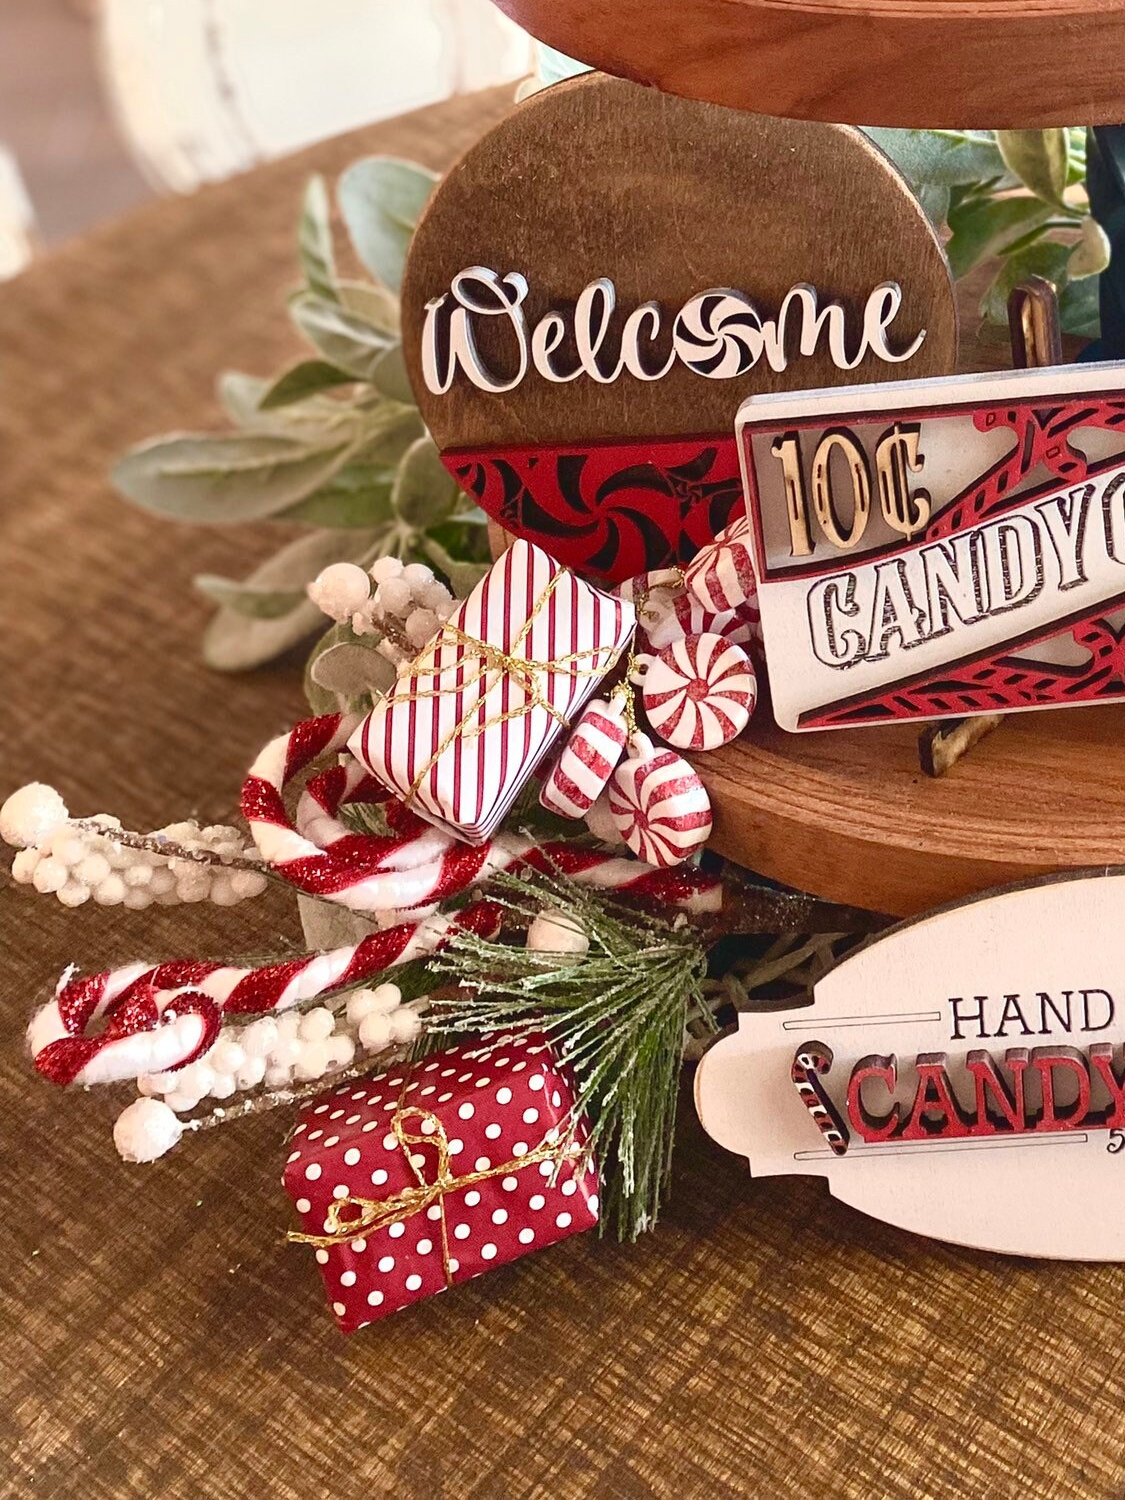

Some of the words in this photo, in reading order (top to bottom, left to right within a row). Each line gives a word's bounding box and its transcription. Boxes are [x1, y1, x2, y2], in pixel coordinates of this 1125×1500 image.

[421, 265, 927, 395] Welcome
[771, 421, 931, 557] 10¢
[806, 483, 1095, 672] CANDY
[948, 988, 1116, 1041] HAND
